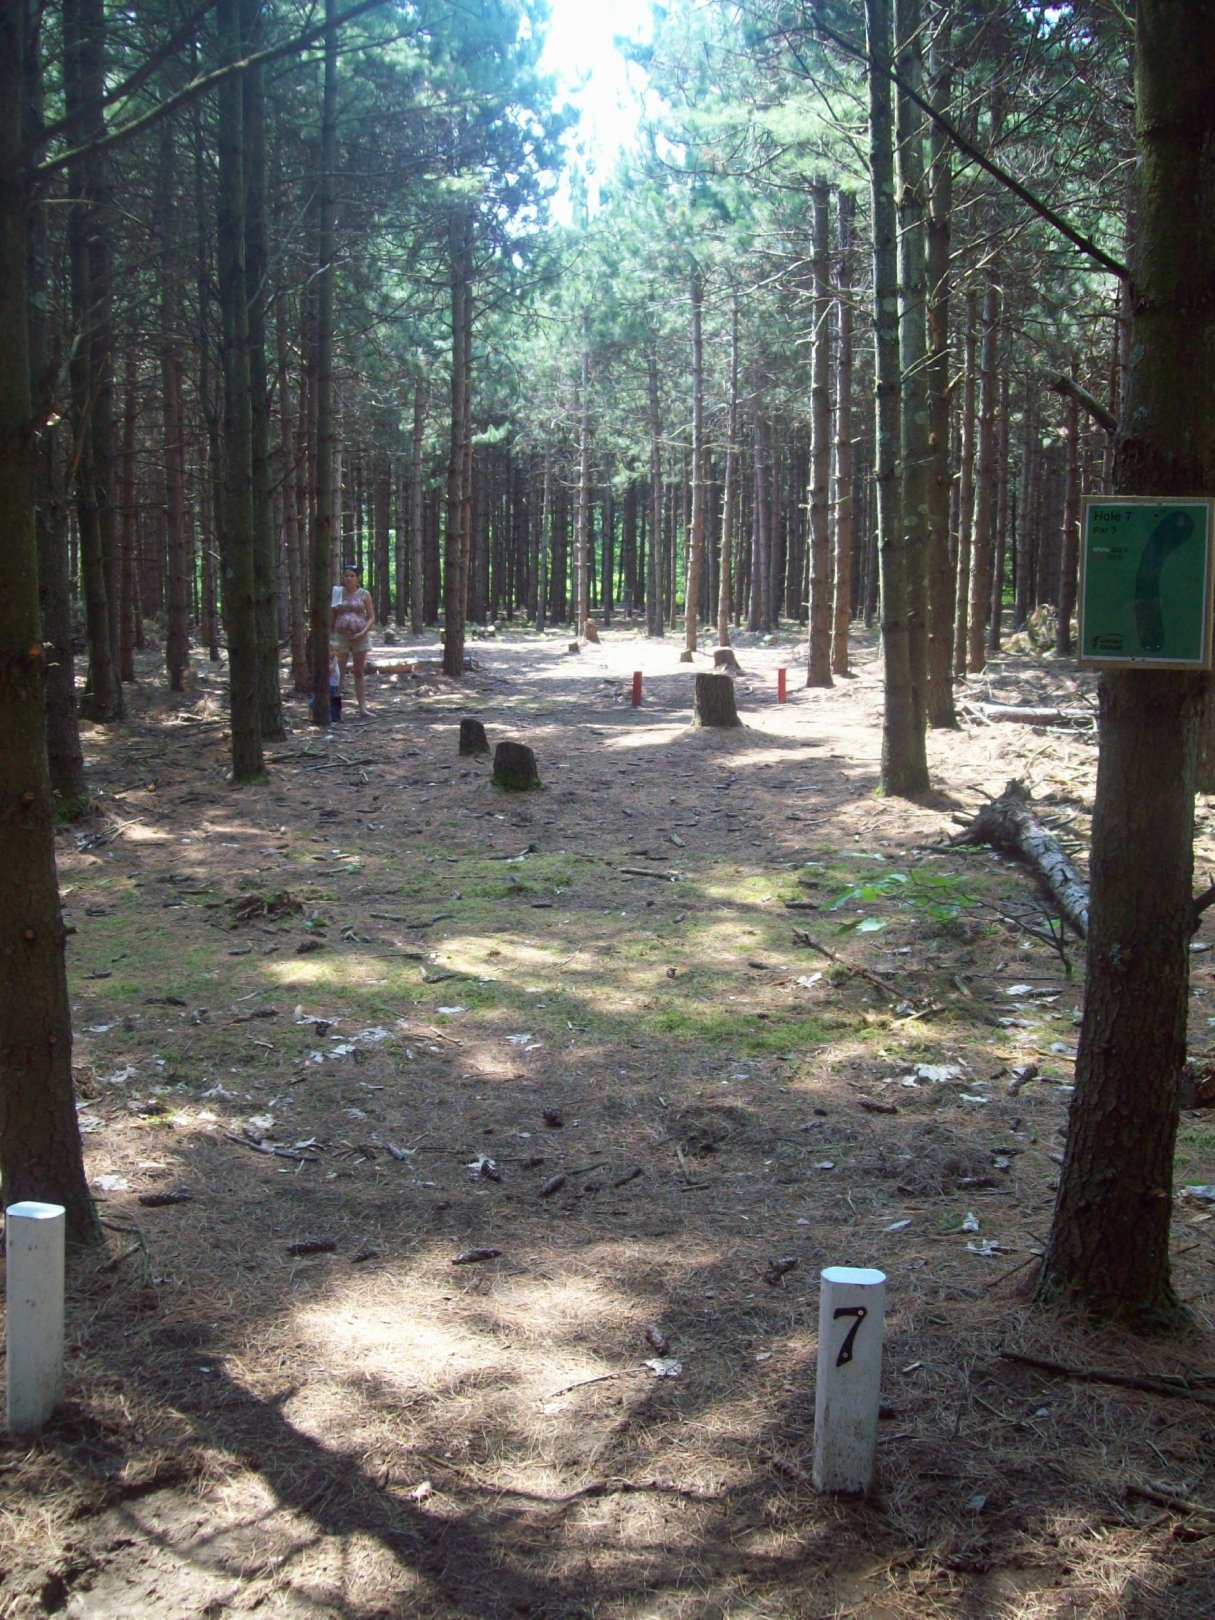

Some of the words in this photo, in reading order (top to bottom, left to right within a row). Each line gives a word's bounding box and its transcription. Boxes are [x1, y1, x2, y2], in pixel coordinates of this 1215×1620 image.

[1094, 511, 1121, 521] Hole
[1125, 511, 1132, 521] 7
[1093, 526, 1109, 534] Par
[1111, 526, 1117, 534] 3
[833, 1306, 868, 1368] 7
